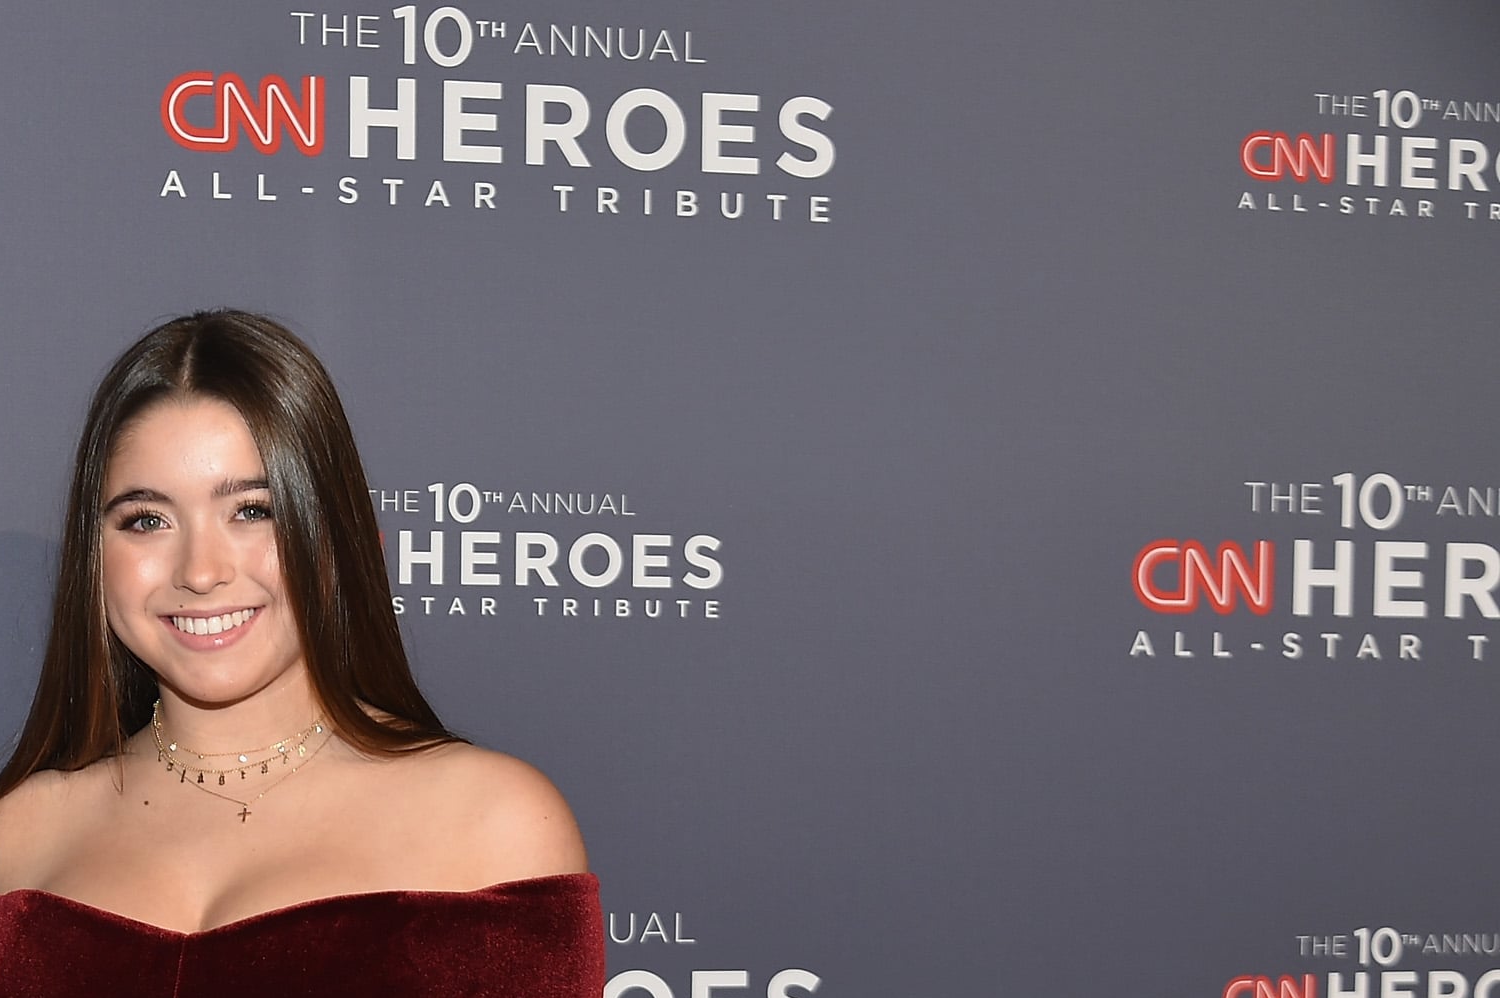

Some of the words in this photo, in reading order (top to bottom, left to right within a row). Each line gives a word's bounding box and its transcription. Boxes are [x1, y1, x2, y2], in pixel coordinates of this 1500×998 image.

[291, 13, 380, 48] THE
[514, 23, 706, 63] ANNUAL
[1314, 94, 1367, 116] THE
[1443, 100, 1500, 122] ANN
[160, 70, 325, 157] CNN
[349, 76, 835, 178] HEROES
[1240, 130, 1336, 183] CNN
[1347, 134, 1500, 191] HER
[161, 171, 495, 208] ALL-STAR
[553, 186, 830, 222] TRIBUTE
[1238, 192, 1433, 217] ALL-STAR
[369, 490, 420, 512] HE
[508, 492, 635, 515] ANNUAL
[1244, 482, 1321, 514] THE
[399, 531, 723, 589] HEROES
[1131, 538, 1275, 616] CNN
[1293, 540, 1500, 618] HER
[392, 597, 496, 615] STAR
[534, 599, 719, 618] TRIBUTE
[1130, 631, 1420, 659] ALL-STAR
[610, 913, 695, 943] UAL
[1296, 936, 1346, 955] THE
[1422, 933, 1500, 954] ANNU
